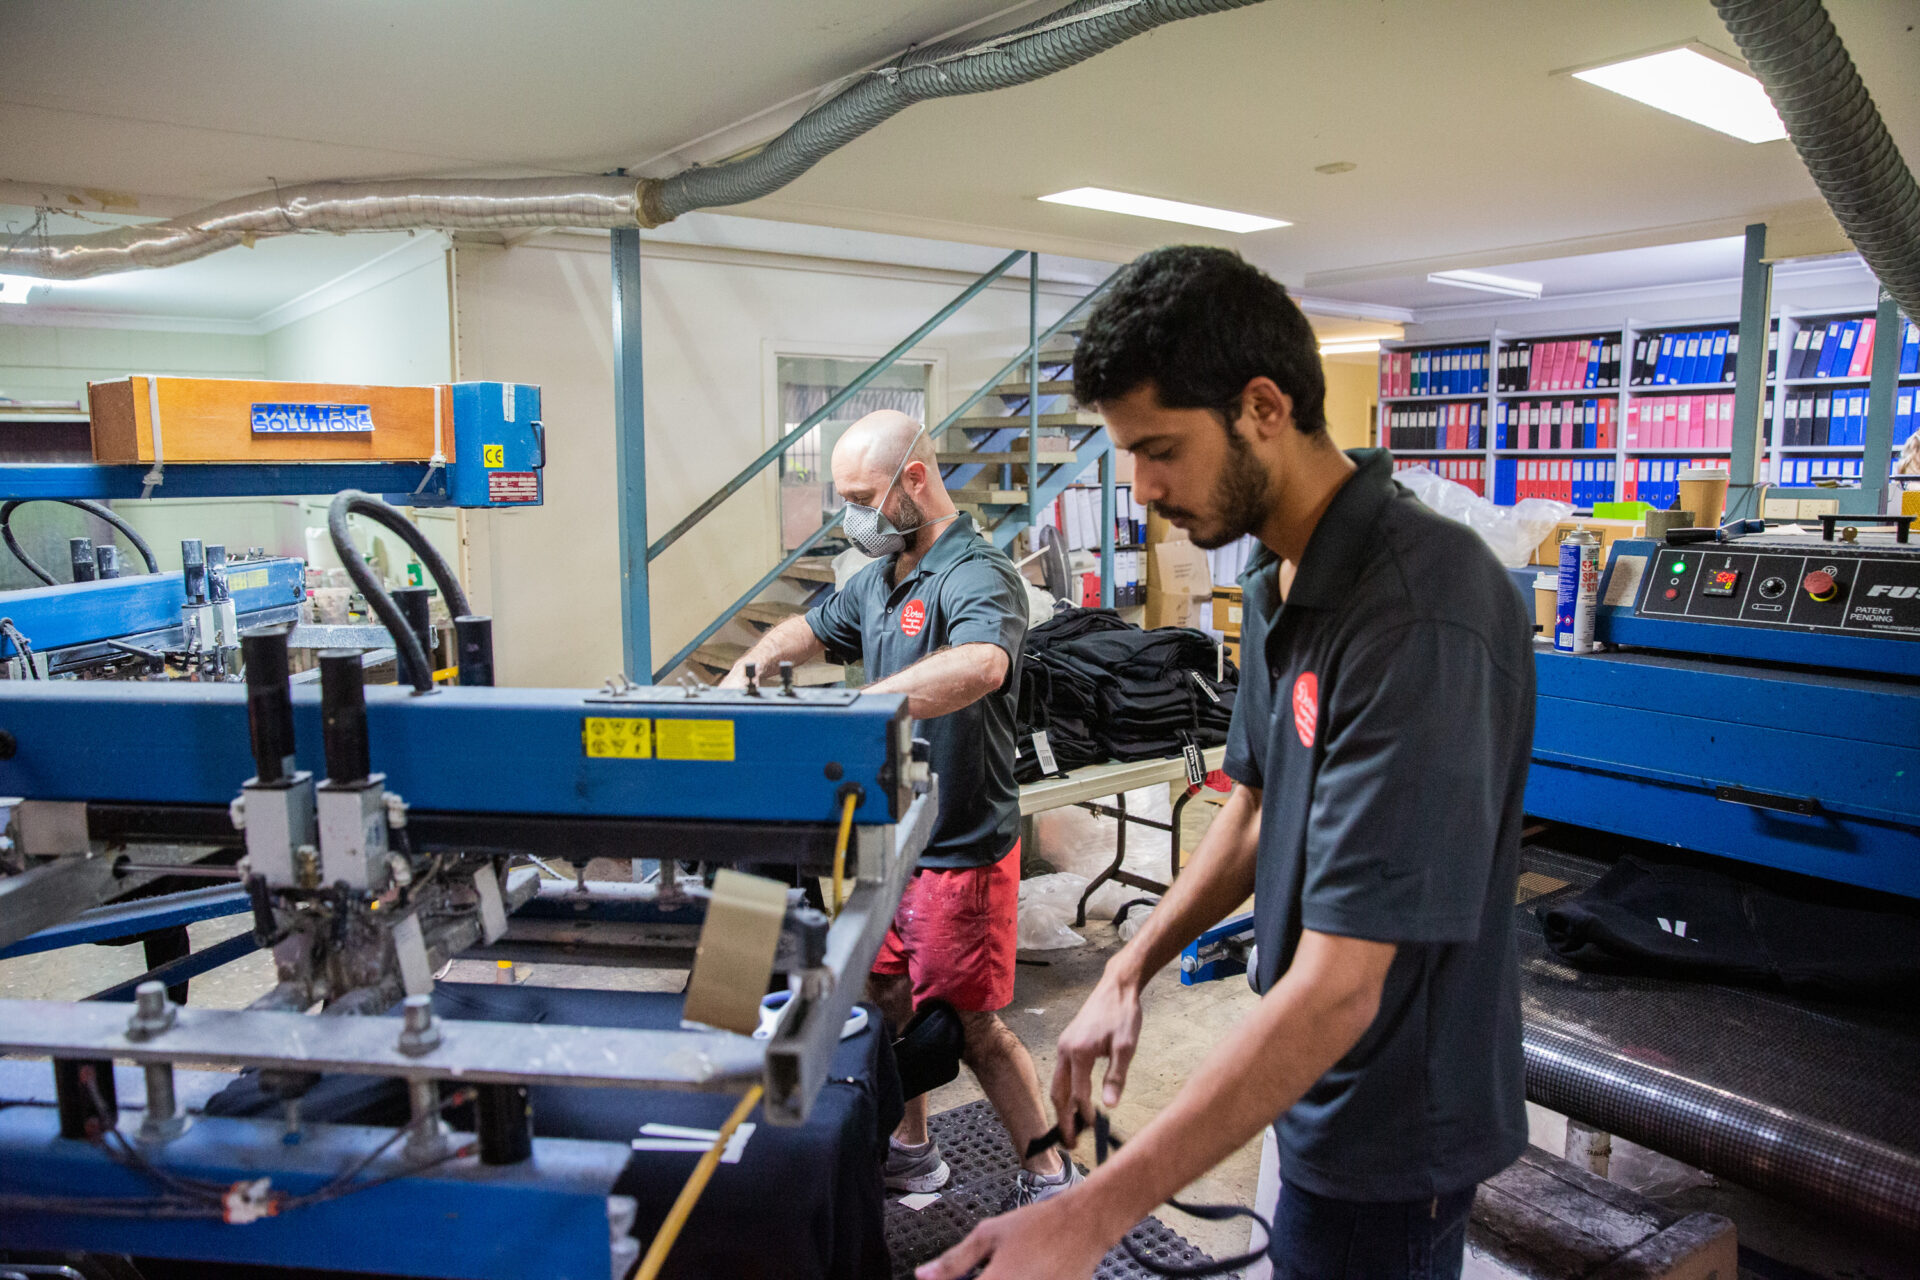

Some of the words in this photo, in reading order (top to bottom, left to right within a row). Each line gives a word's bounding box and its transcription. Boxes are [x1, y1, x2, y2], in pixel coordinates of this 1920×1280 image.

[253, 404, 308, 420] RAW
[253, 418, 373, 431] SOLUTIONS
[485, 448, 502, 463] CE
[1866, 584, 1920, 599] FU
[1849, 613, 1894, 623] PENDING
[1855, 606, 1892, 616] PATENT
